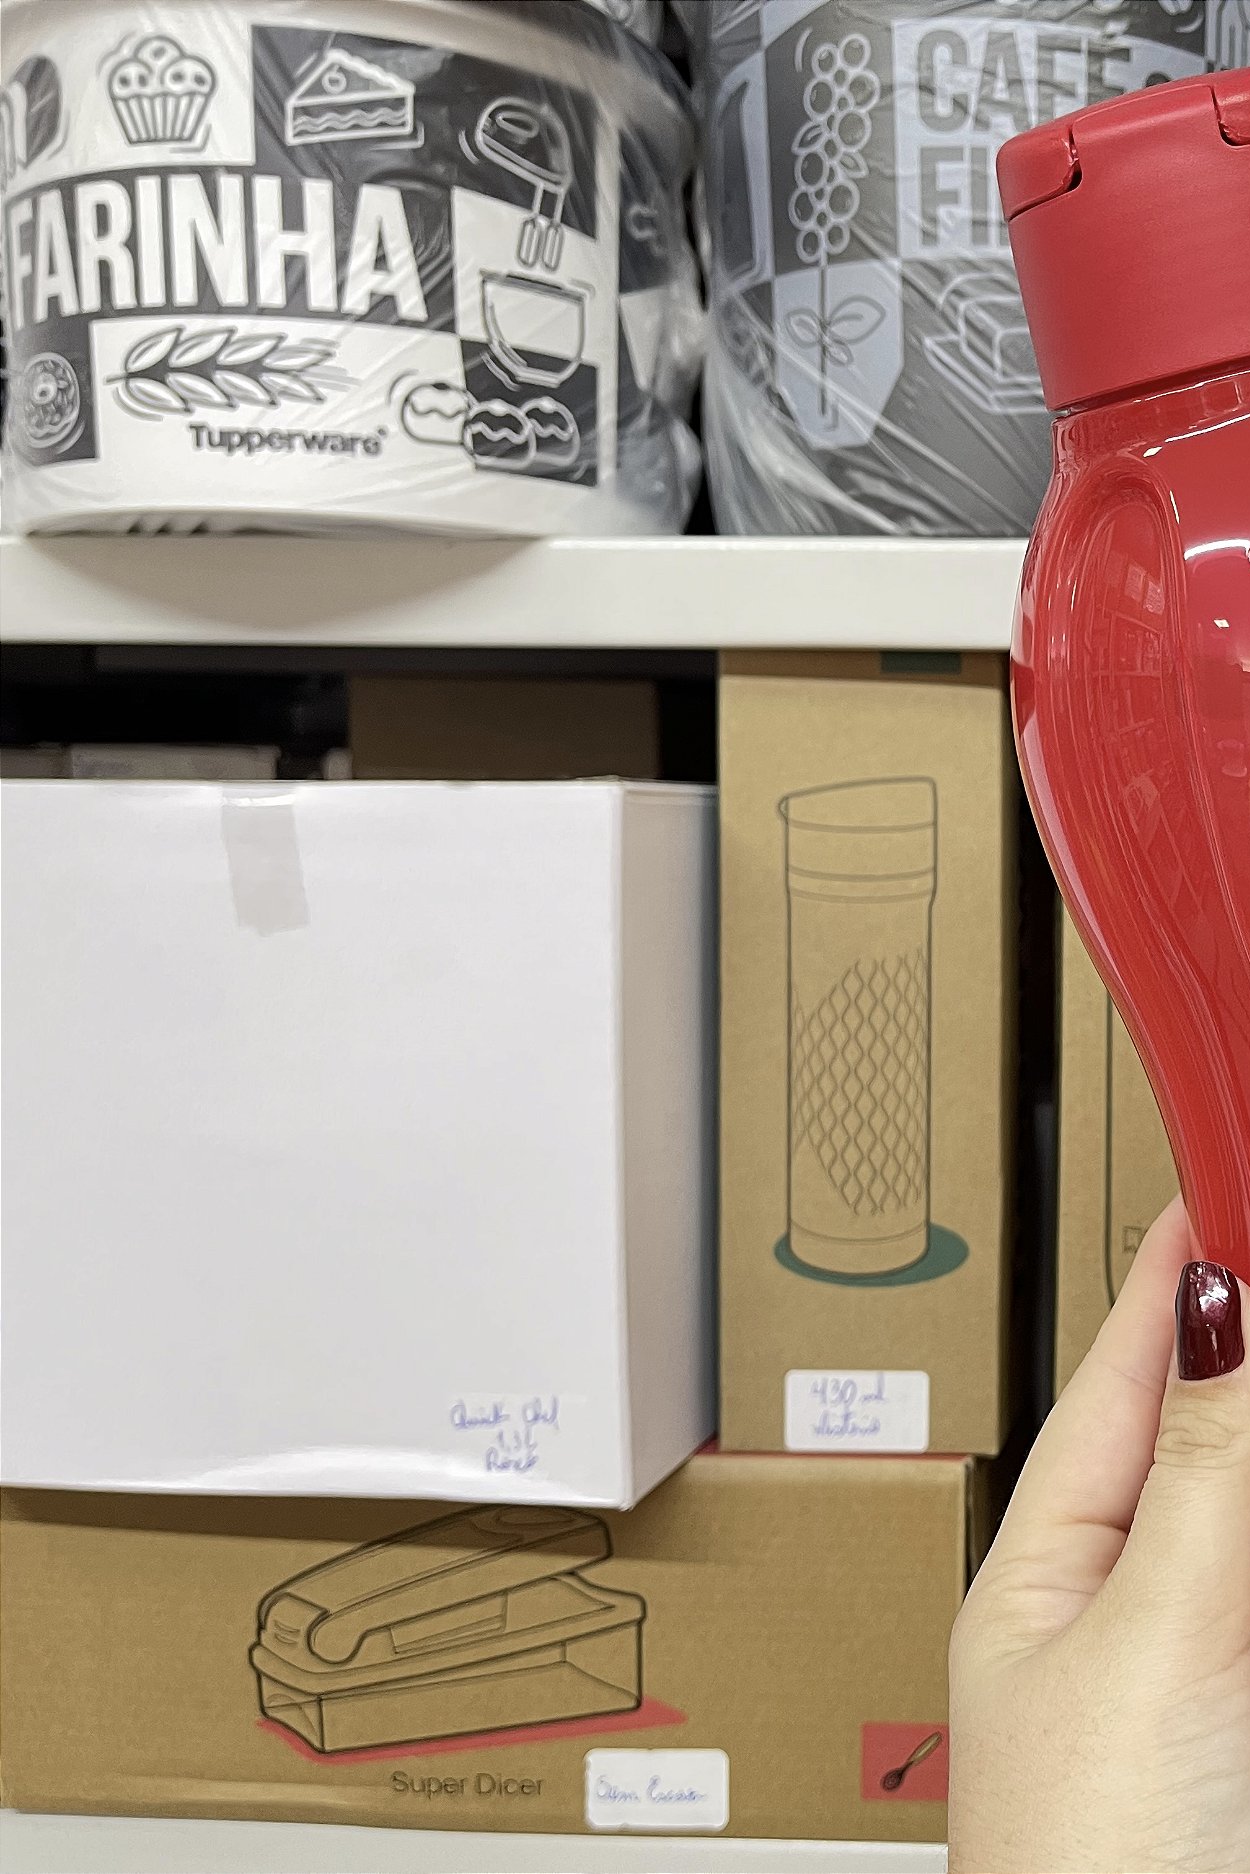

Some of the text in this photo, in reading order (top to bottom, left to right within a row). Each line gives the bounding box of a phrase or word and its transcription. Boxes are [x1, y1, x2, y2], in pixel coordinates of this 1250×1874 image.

[10, 173, 428, 331] FARINHA
[188, 422, 384, 456] Tupperware
[390, 1769, 544, 1801] Super Dicer
